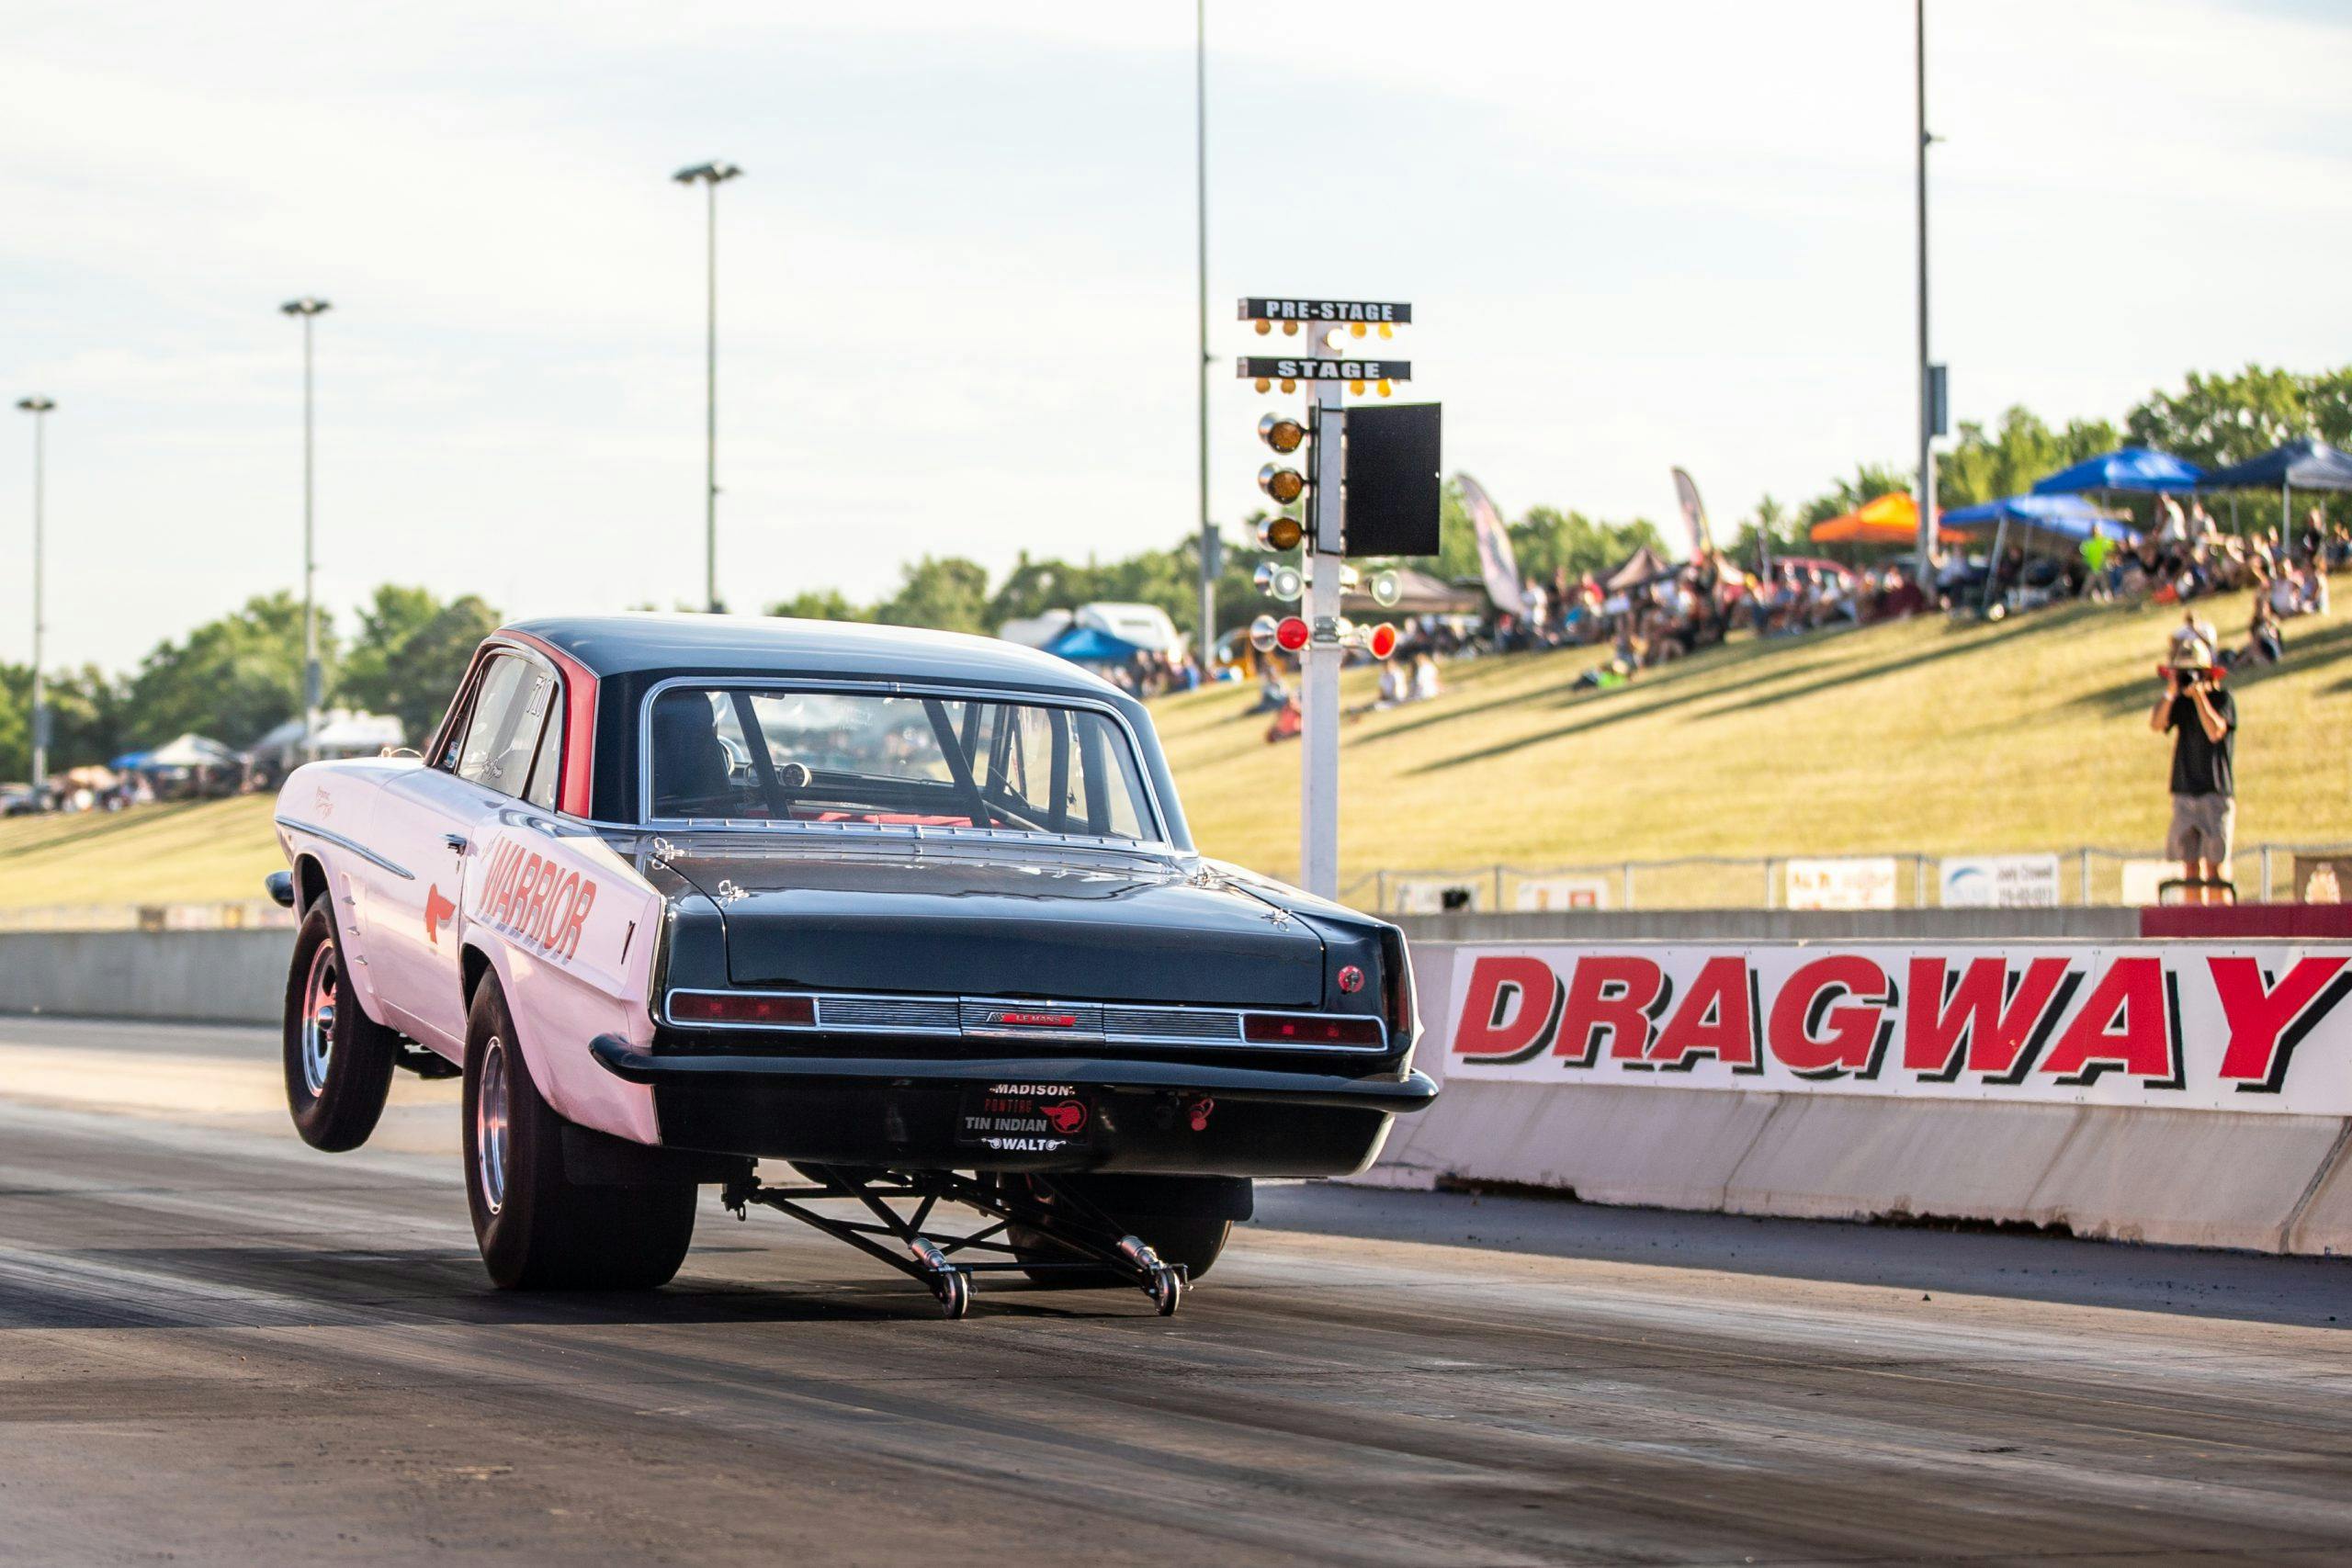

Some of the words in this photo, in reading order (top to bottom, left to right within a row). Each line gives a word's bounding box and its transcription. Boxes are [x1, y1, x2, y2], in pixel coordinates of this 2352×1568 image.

[1266, 300, 1393, 321] PRE-STAGE
[1277, 360, 1381, 378] STAGE
[477, 836, 597, 962] WARRIOR
[1016, 1012, 1029, 1021] LE
[1452, 953, 2352, 1093] DRAGWAY
[995, 1084, 1069, 1096] MADISON
[965, 1116, 991, 1130] TIN
[994, 1117, 1048, 1132] INDIAN
[1002, 1138, 1046, 1151] WALT
